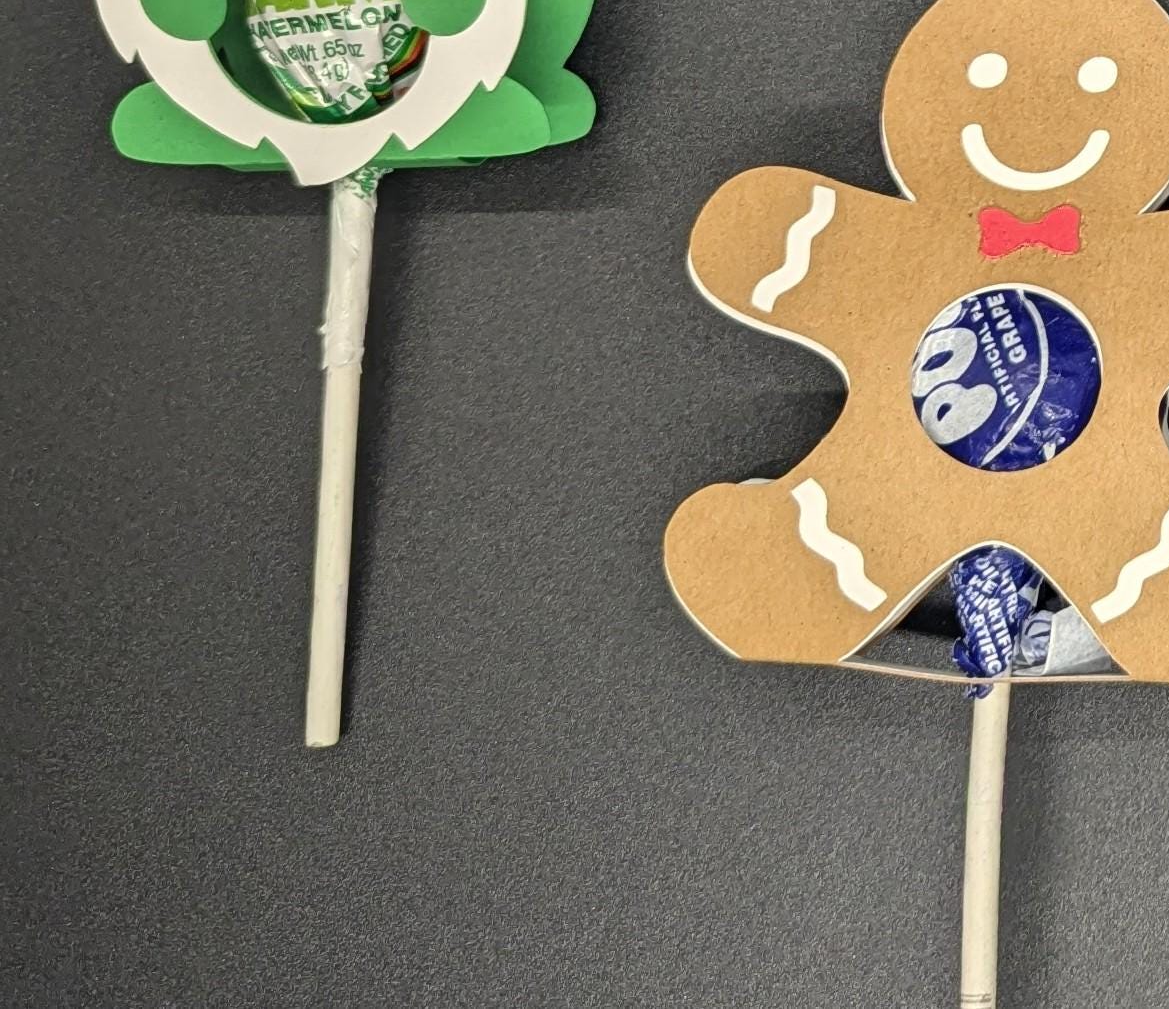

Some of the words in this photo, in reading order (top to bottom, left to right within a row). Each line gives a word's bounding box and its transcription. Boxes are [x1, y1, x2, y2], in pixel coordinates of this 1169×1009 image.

[249, 5, 401, 40] ERMELON
[979, 322, 1020, 407] RTIFICIAL
[986, 292, 1028, 365] GRAPE
